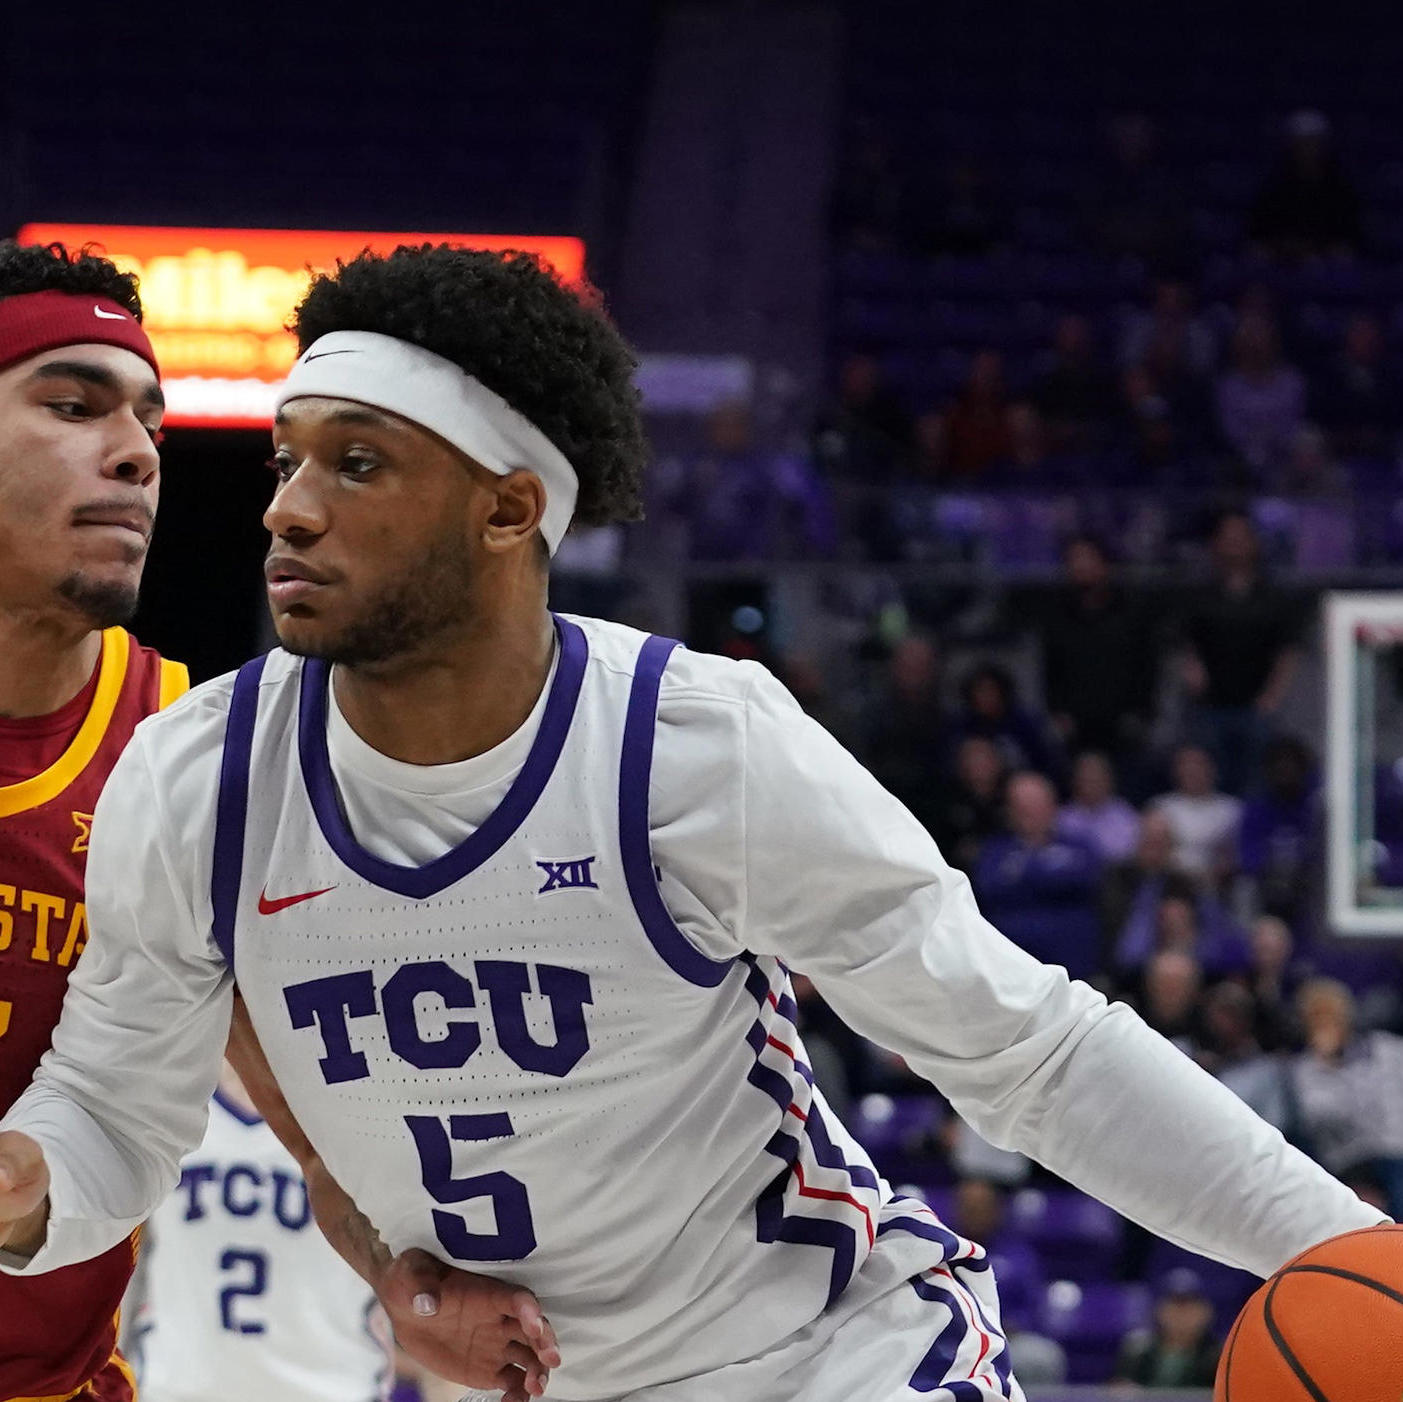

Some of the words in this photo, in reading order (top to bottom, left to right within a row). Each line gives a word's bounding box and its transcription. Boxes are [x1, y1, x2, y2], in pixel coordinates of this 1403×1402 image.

[536, 856, 599, 894] XII
[282, 960, 594, 1085] TCU
[177, 1164, 310, 1232] TCU
[403, 1112, 537, 1262] 5
[220, 1248, 267, 1335] 2
